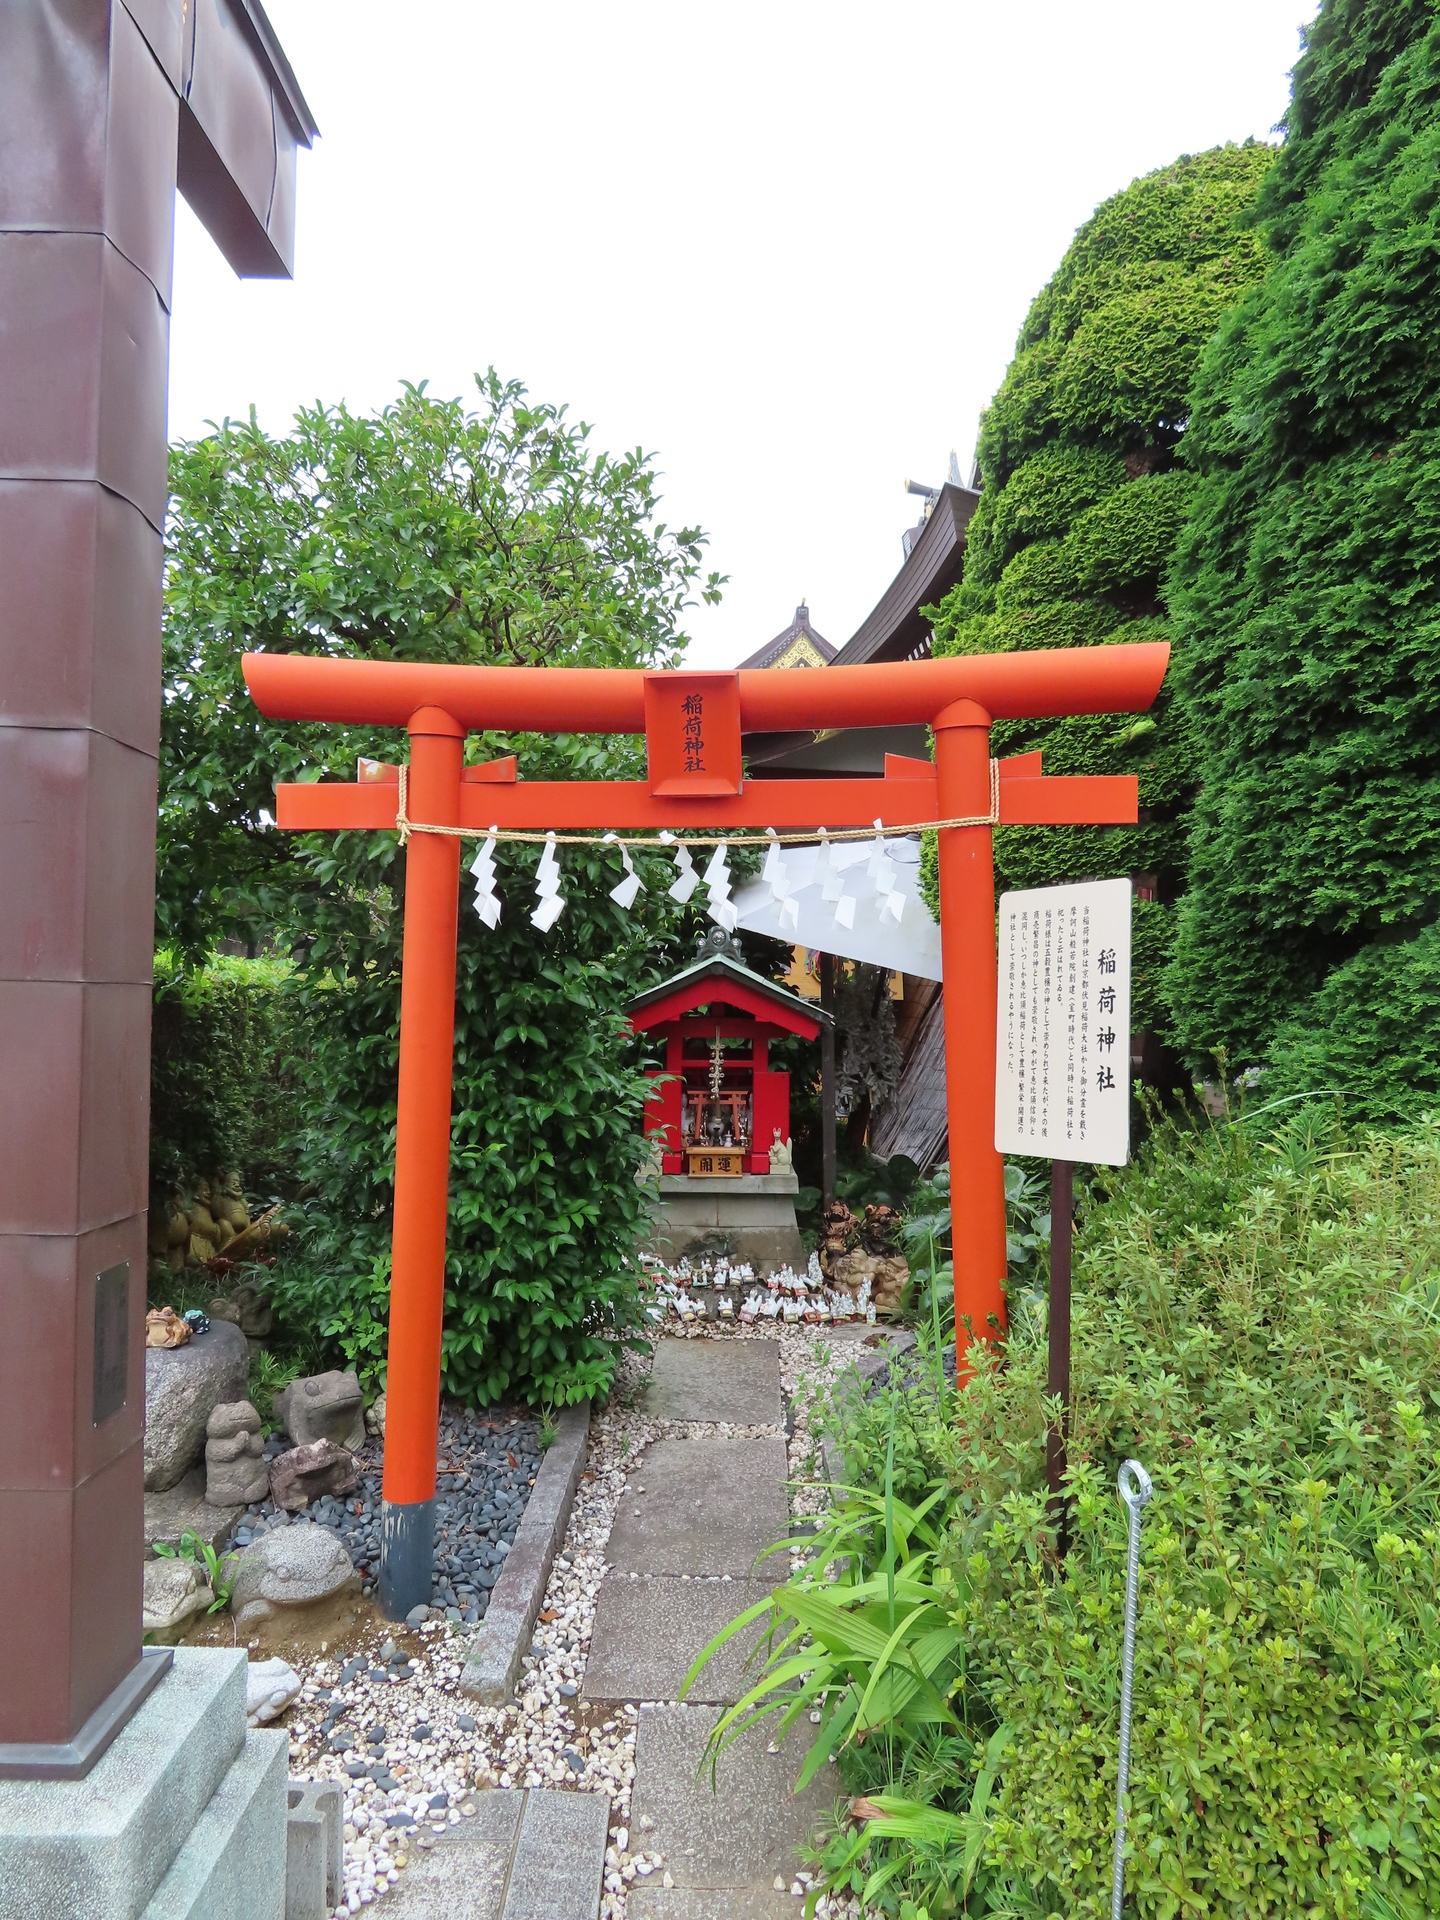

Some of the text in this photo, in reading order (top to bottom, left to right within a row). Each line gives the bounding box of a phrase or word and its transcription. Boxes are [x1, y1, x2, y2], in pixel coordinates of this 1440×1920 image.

[681, 693, 706, 773] 稲荷神社
[1096, 948, 1117, 1093] 稲荷神社
